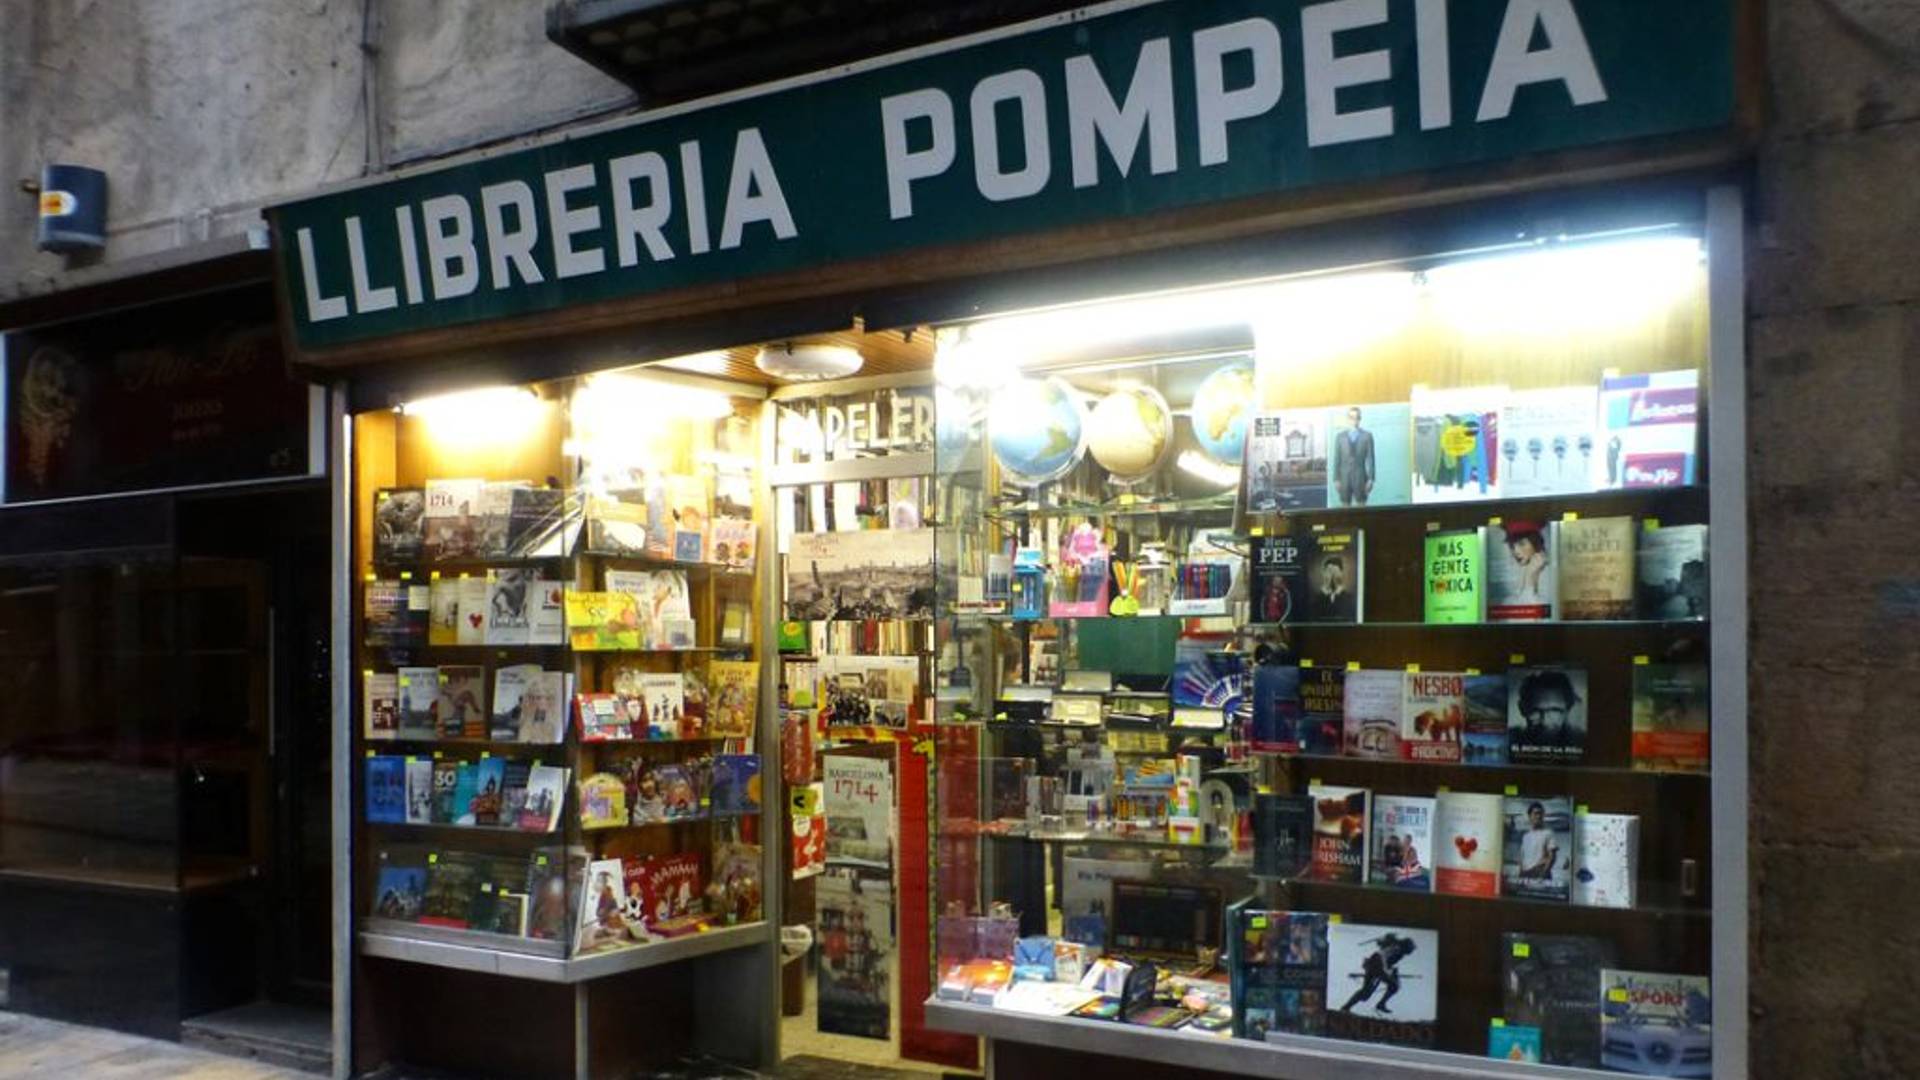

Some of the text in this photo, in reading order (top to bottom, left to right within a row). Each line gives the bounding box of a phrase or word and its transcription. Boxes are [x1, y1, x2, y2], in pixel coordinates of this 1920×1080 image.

[298, 0, 1608, 324] LLIBRERIA POMPEIA
[1259, 547, 1298, 563] PEP
[1432, 558, 1470, 576] GENTE
[434, 770, 457, 787] 30
[832, 778, 879, 804] 1714
[1628, 989, 1686, 1007] SPORT
